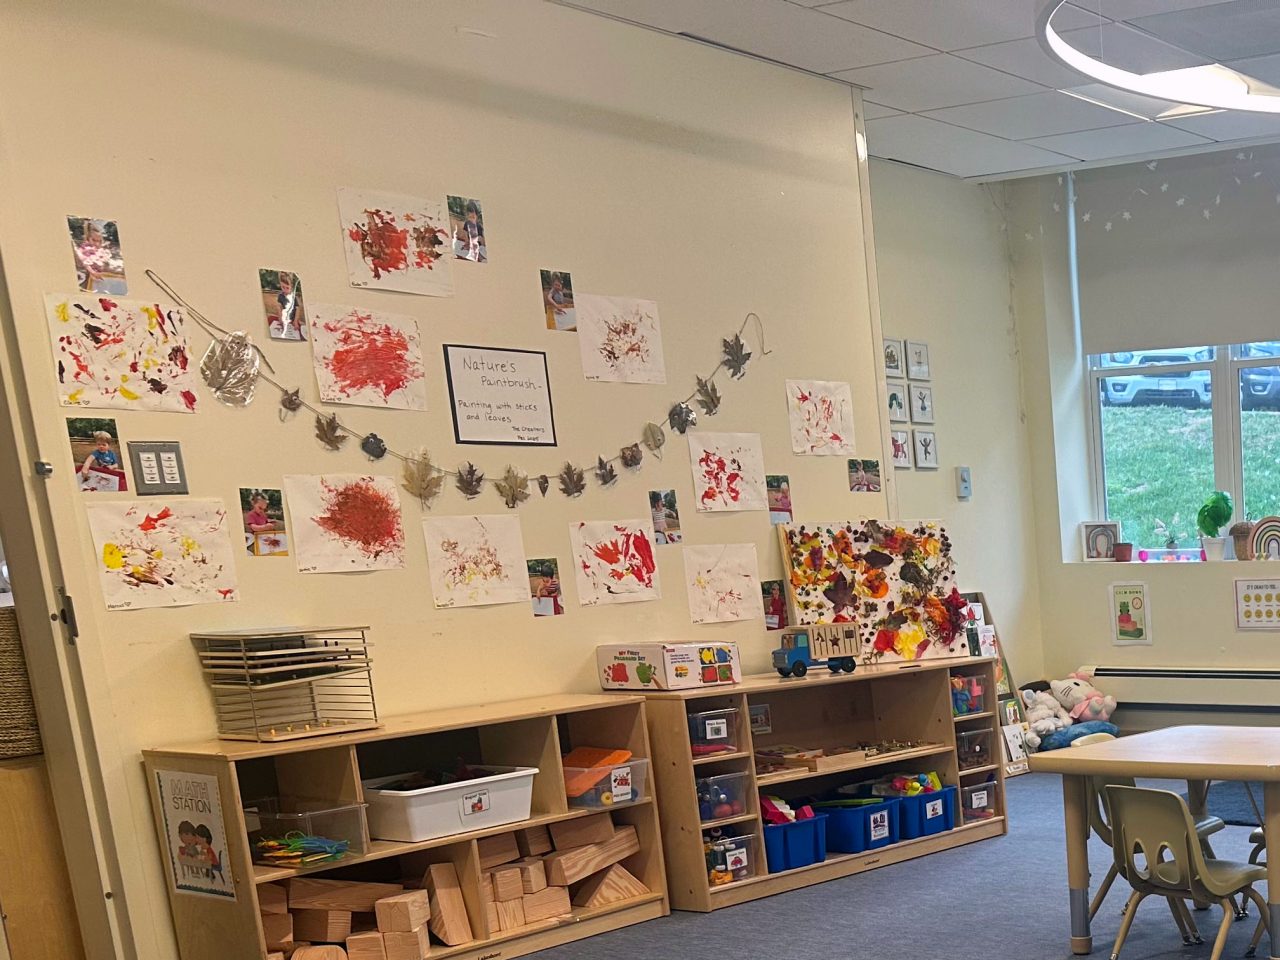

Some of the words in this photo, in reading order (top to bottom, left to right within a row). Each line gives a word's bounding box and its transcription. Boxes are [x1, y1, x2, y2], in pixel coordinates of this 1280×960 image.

[463, 356, 516, 373] Nature's
[458, 400, 492, 413] Painting
[496, 402, 511, 410] with
[516, 402, 538, 411] sticks
[485, 413, 511, 423] leaves
[170, 779, 209, 799] MATH
[172, 796, 211, 813] STATION
